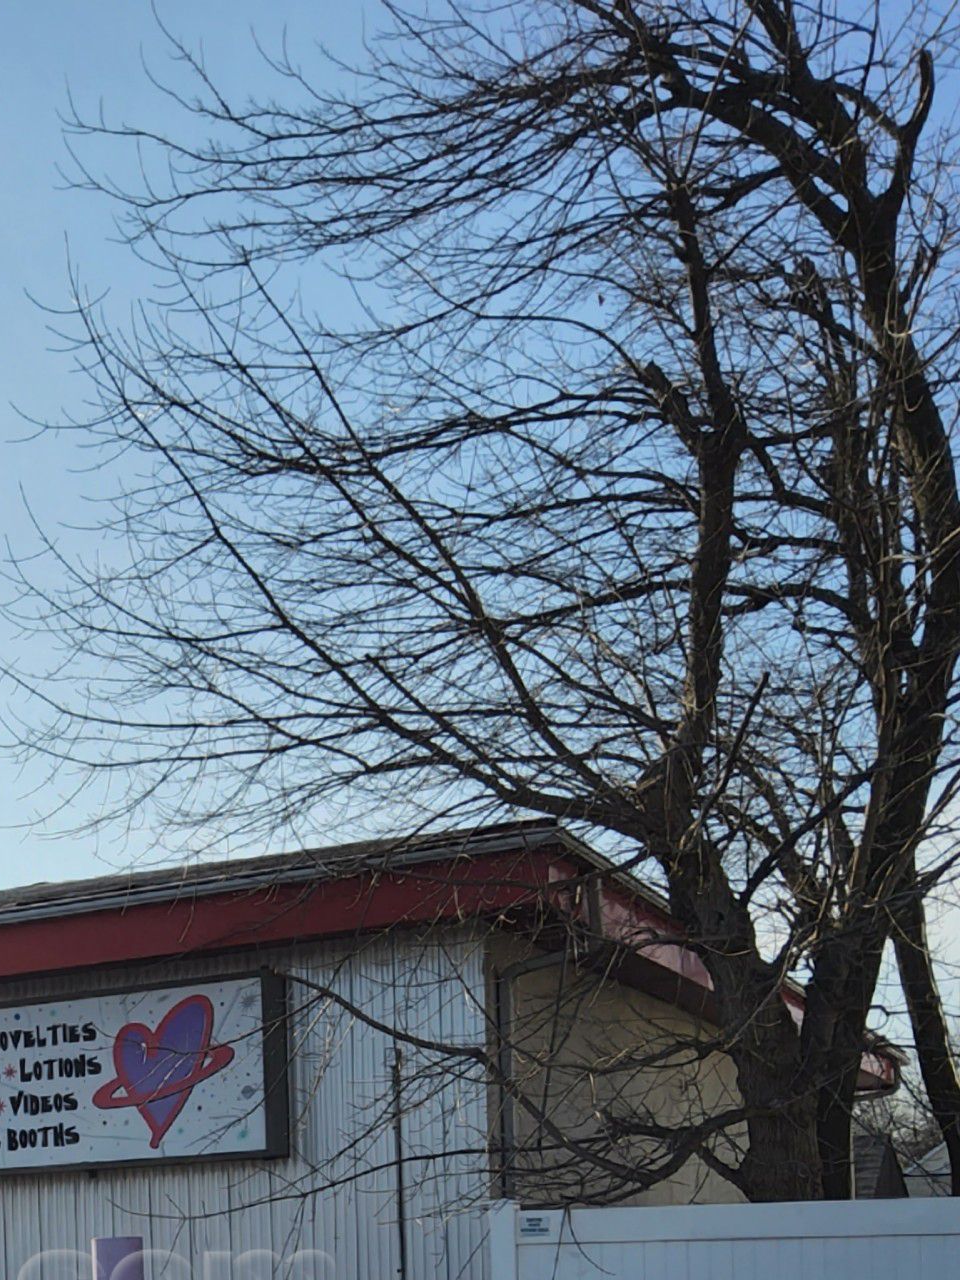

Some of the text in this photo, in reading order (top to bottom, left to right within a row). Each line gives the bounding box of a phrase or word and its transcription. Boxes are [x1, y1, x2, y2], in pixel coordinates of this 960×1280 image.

[19, 1054, 102, 1083] LOTIONS
[8, 1092, 79, 1117] VIDEOS
[6, 1122, 80, 1151] BOOTHS
